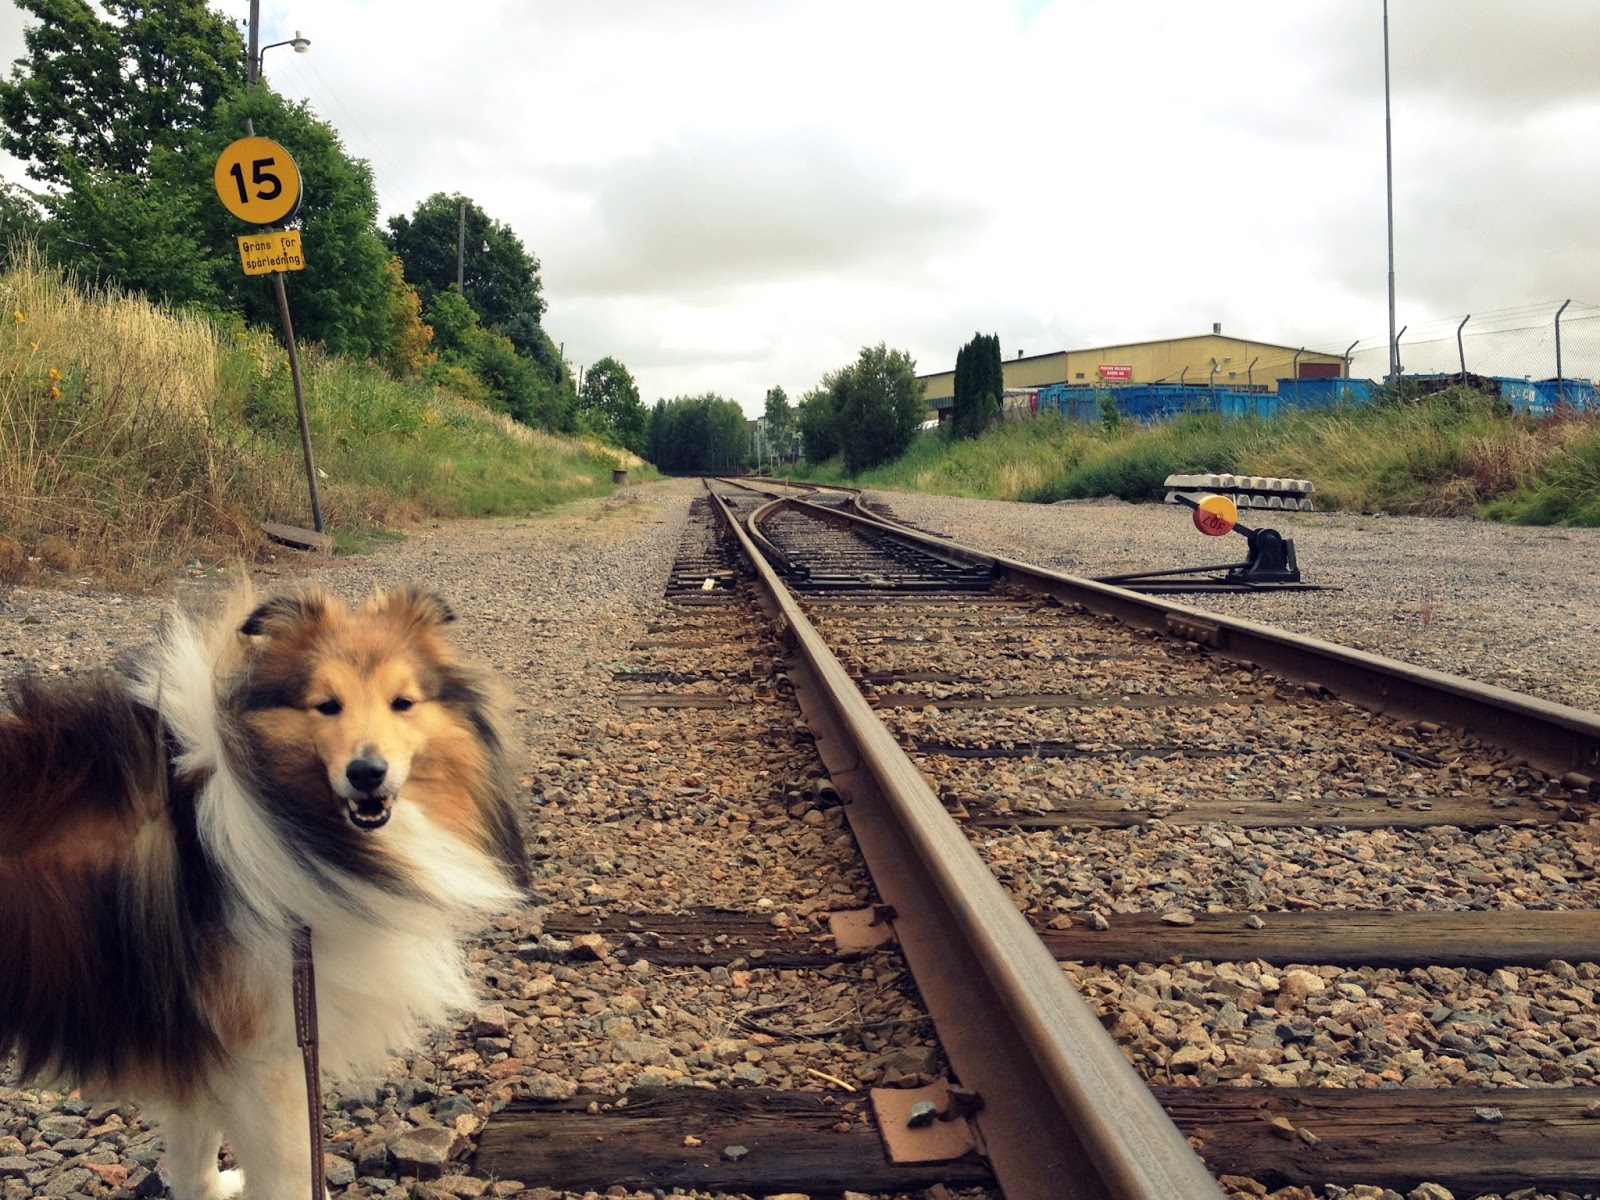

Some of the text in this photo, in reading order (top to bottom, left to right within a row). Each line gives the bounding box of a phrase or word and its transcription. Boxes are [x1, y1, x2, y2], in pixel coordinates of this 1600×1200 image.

[230, 158, 282, 203] 15
[243, 237, 296, 252] Gräns för
[246, 255, 300, 270] spårledning
